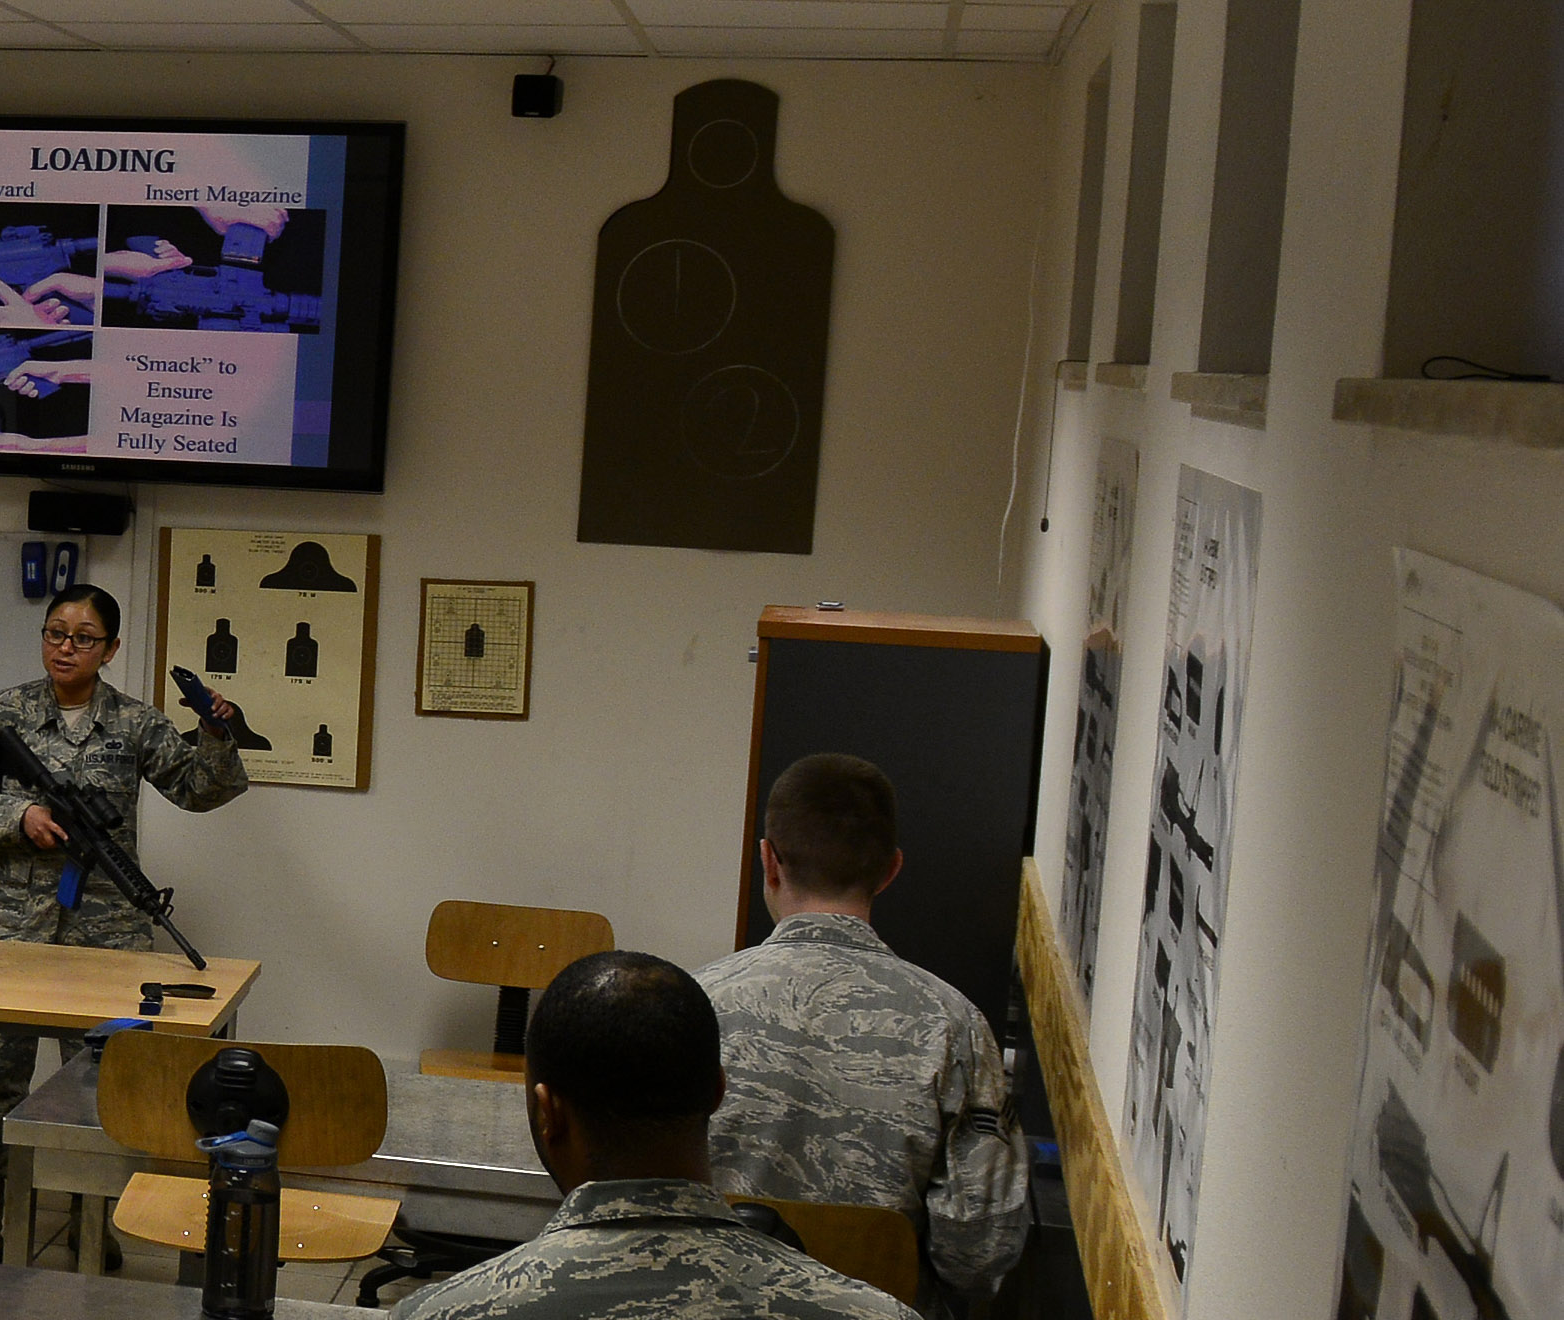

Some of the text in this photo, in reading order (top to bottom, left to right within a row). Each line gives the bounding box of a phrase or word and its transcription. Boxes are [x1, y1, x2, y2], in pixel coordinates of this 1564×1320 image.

[30, 147, 175, 173] LOADING
[145, 184, 302, 207] Insert Magazine
[125, 355, 237, 375] “Smack” to
[146, 382, 213, 400] Ensure
[120, 407, 237, 428] Magazine Is
[117, 433, 238, 454] Fully Seated
[61, 463, 95, 472] SAMSUNG
